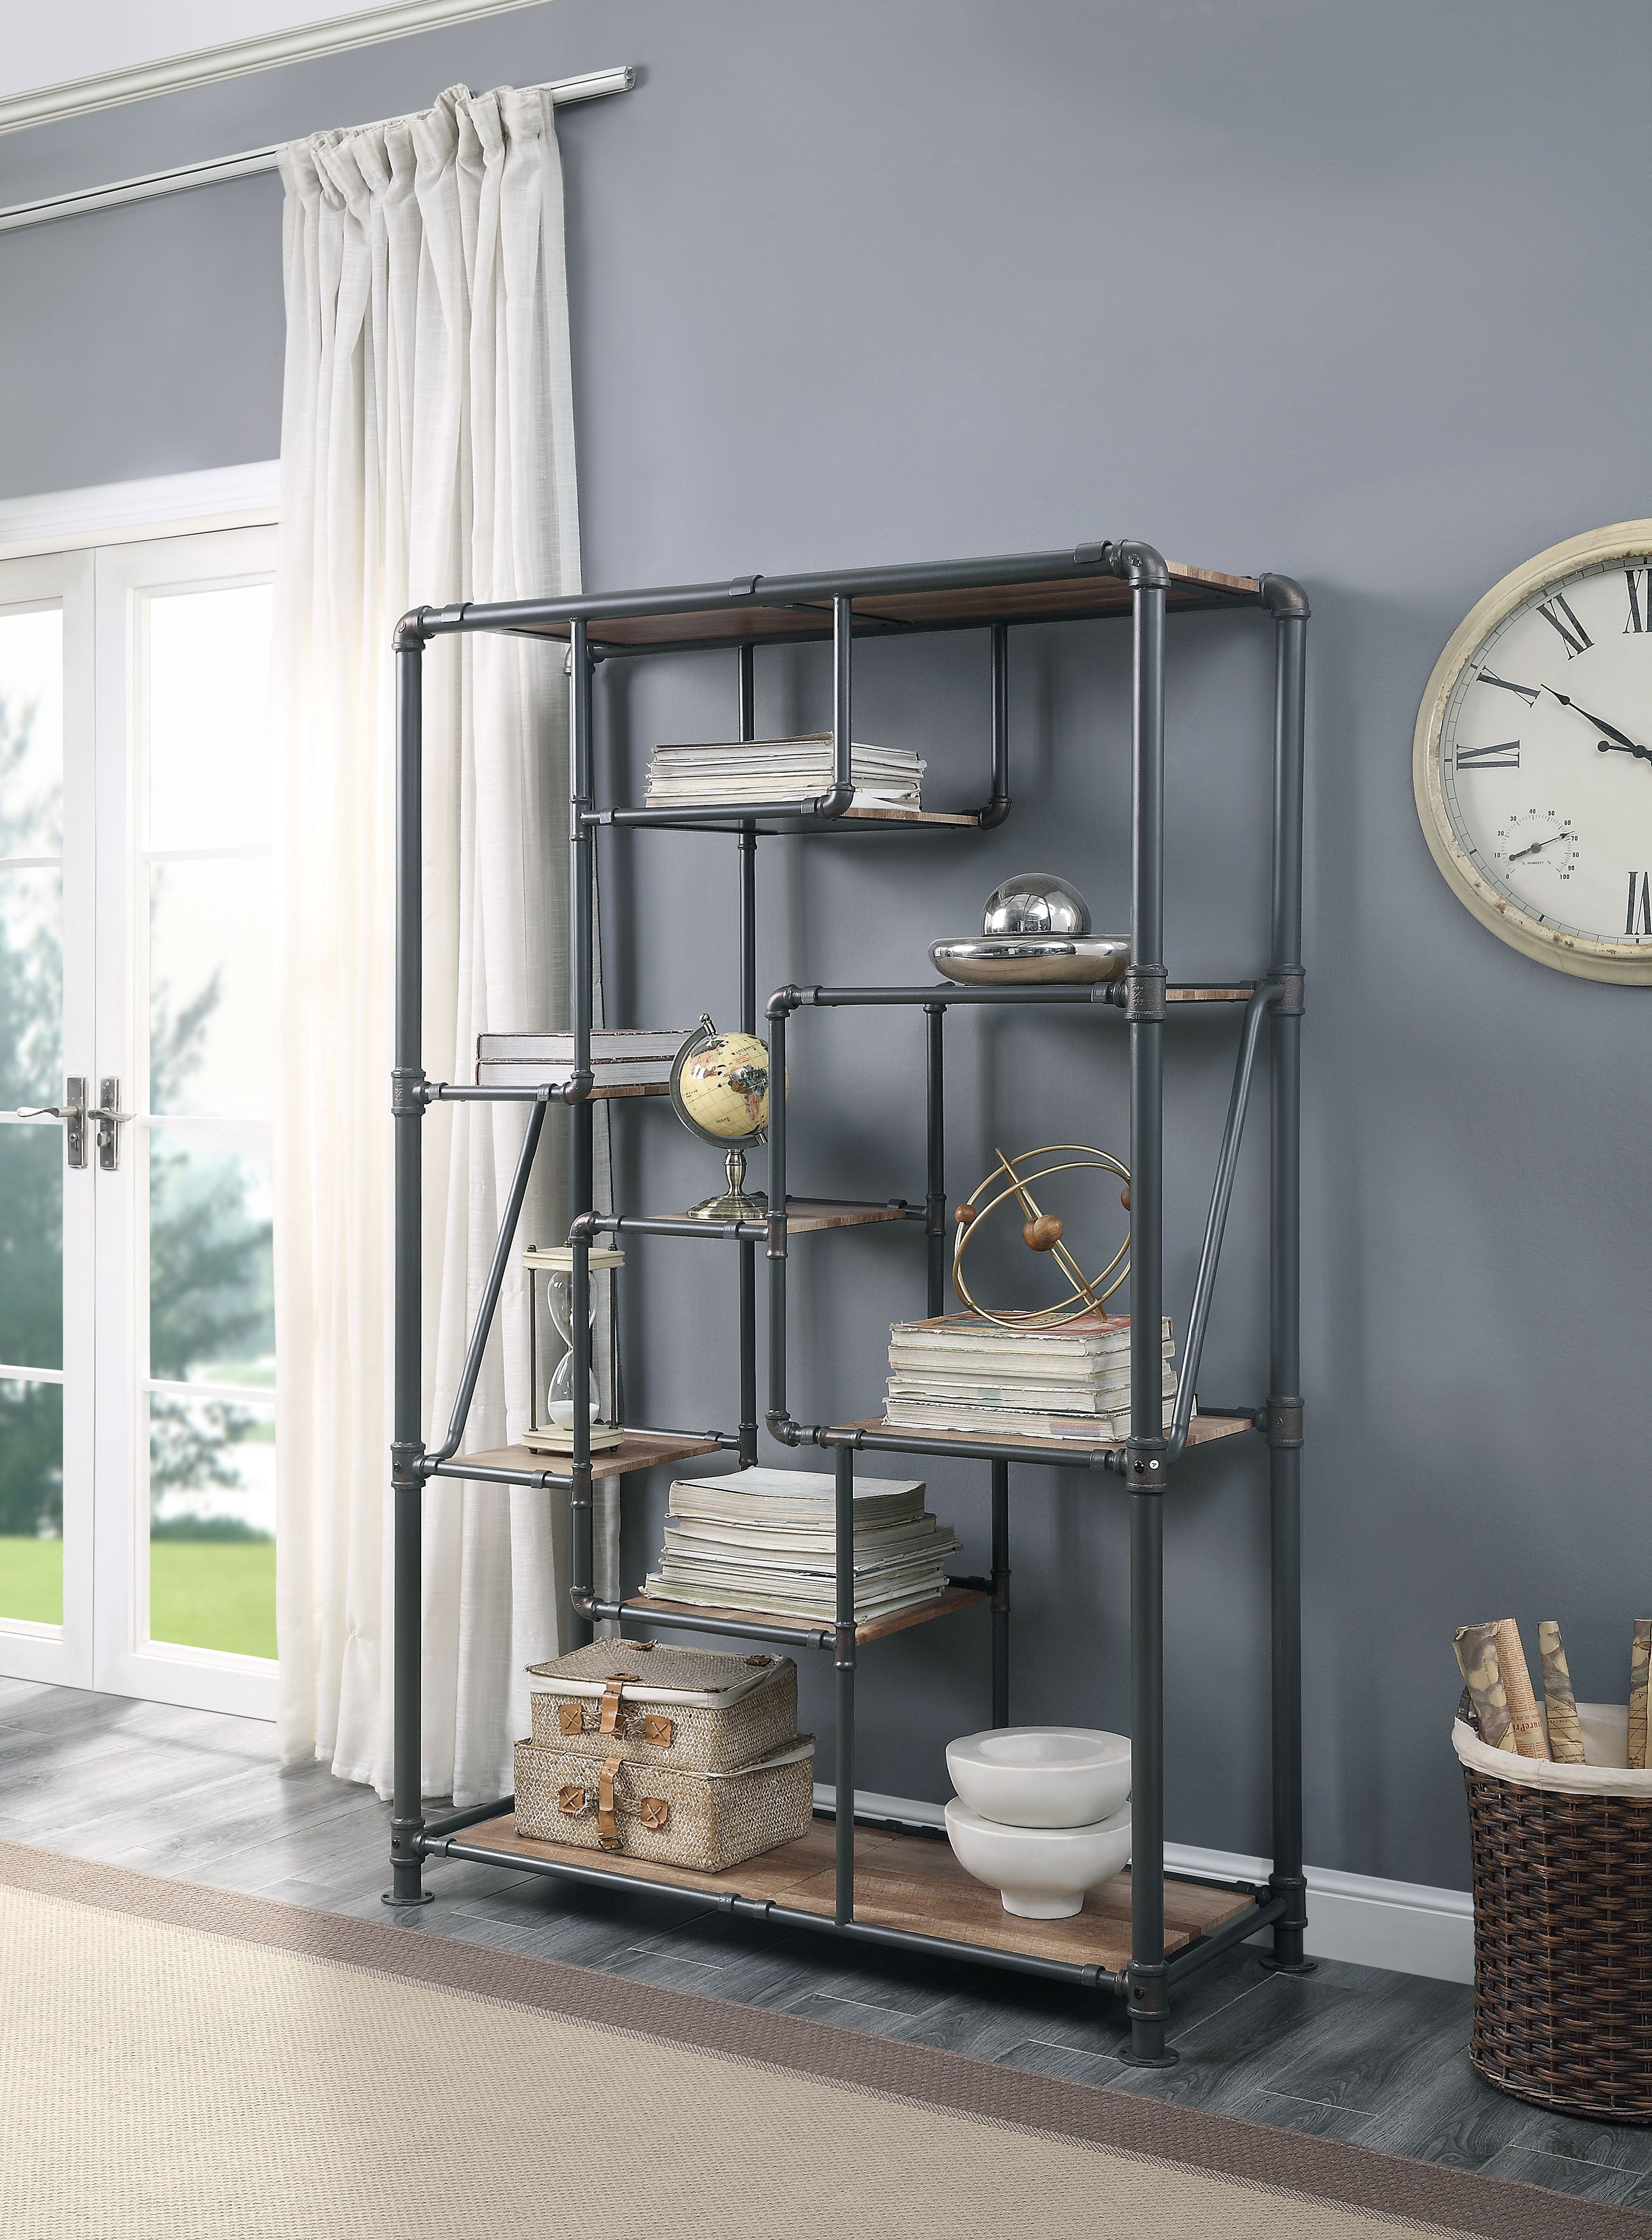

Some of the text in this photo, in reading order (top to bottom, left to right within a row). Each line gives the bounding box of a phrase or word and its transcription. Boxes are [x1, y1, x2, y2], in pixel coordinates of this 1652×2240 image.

[1536, 593, 1594, 660] XI
[1476, 665, 1541, 707] X
[1456, 740, 1520, 770] IX
